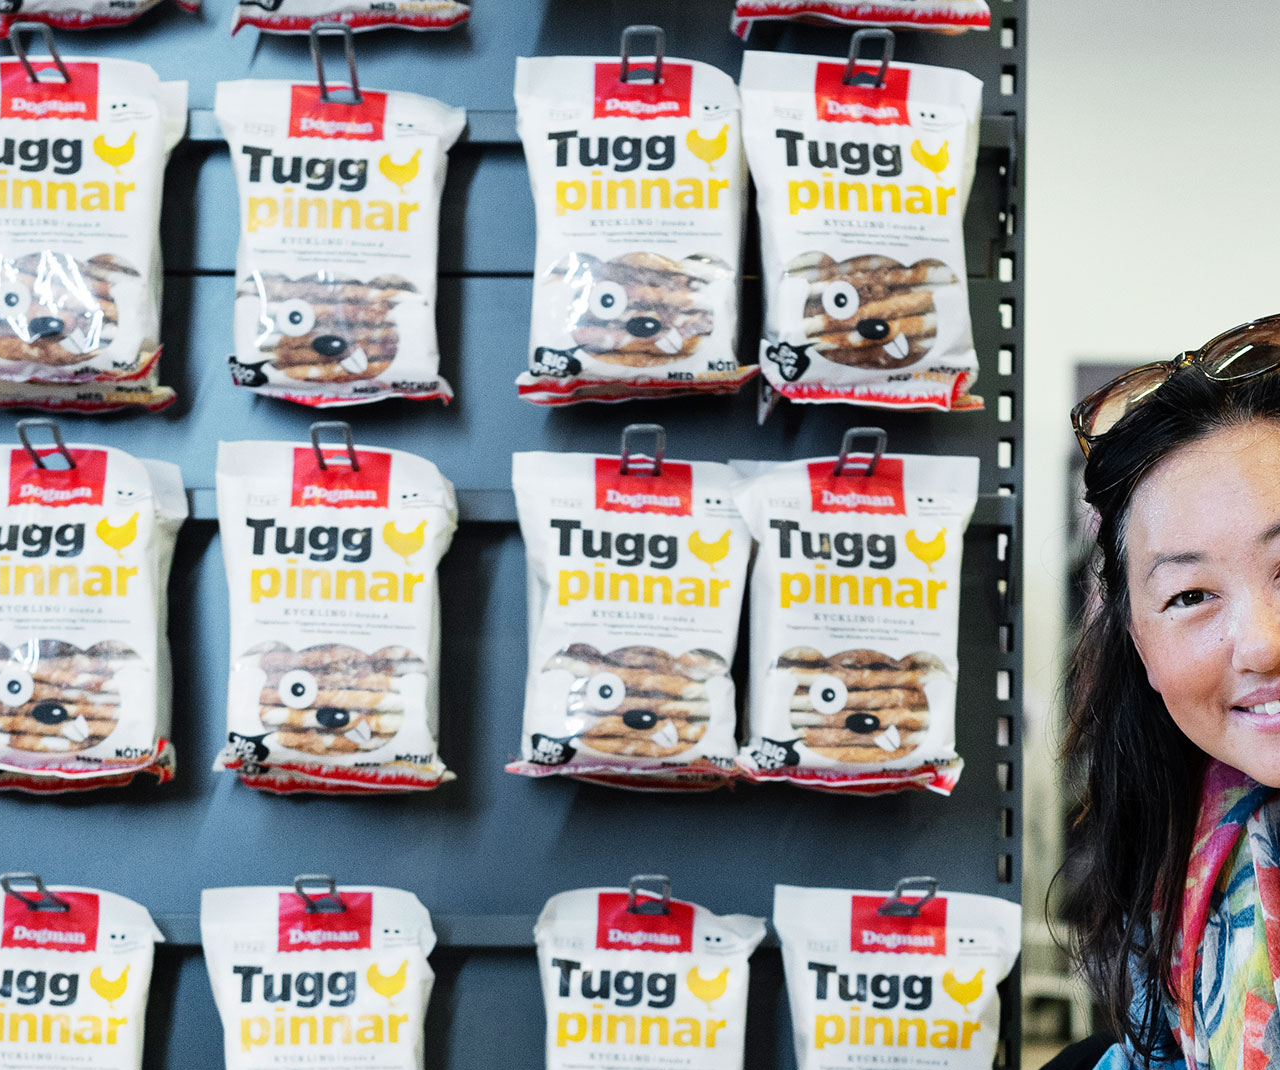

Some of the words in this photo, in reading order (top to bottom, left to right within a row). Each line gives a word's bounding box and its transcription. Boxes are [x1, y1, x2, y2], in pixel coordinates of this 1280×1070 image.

[10, 97, 87, 116] Dogman
[605, 98, 680, 115] Dogman
[242, 145, 368, 192] Tugg
[548, 130, 676, 172] Tugg
[775, 129, 902, 177] Tugg
[246, 188, 420, 232] pinnar
[555, 170, 730, 216] pinnar
[787, 172, 957, 216] pinnar
[19, 483, 93, 501] Dogman
[302, 484, 378, 504] Dogman
[606, 489, 681, 508] Dogman
[822, 490, 896, 508] Dogman
[246, 517, 373, 562] Tugg
[550, 519, 678, 569] Tugg
[770, 519, 896, 569] Tugg
[250, 559, 425, 603] pinnar
[558, 563, 731, 608] pinnar
[780, 564, 948, 610] pinnar
[813, 613, 875, 623] KYCKLING
[13, 926, 87, 944] Dogman
[288, 929, 360, 944] Dogman
[608, 929, 681, 946] Dogman
[862, 930, 936, 948] Dogman
[233, 965, 357, 1008] Tugg
[552, 958, 676, 1008] Tugg
[808, 962, 932, 1011] Tugg
[240, 1008, 410, 1052] pinnar
[556, 1004, 727, 1048] pinnar
[814, 1006, 982, 1050] pinnar
